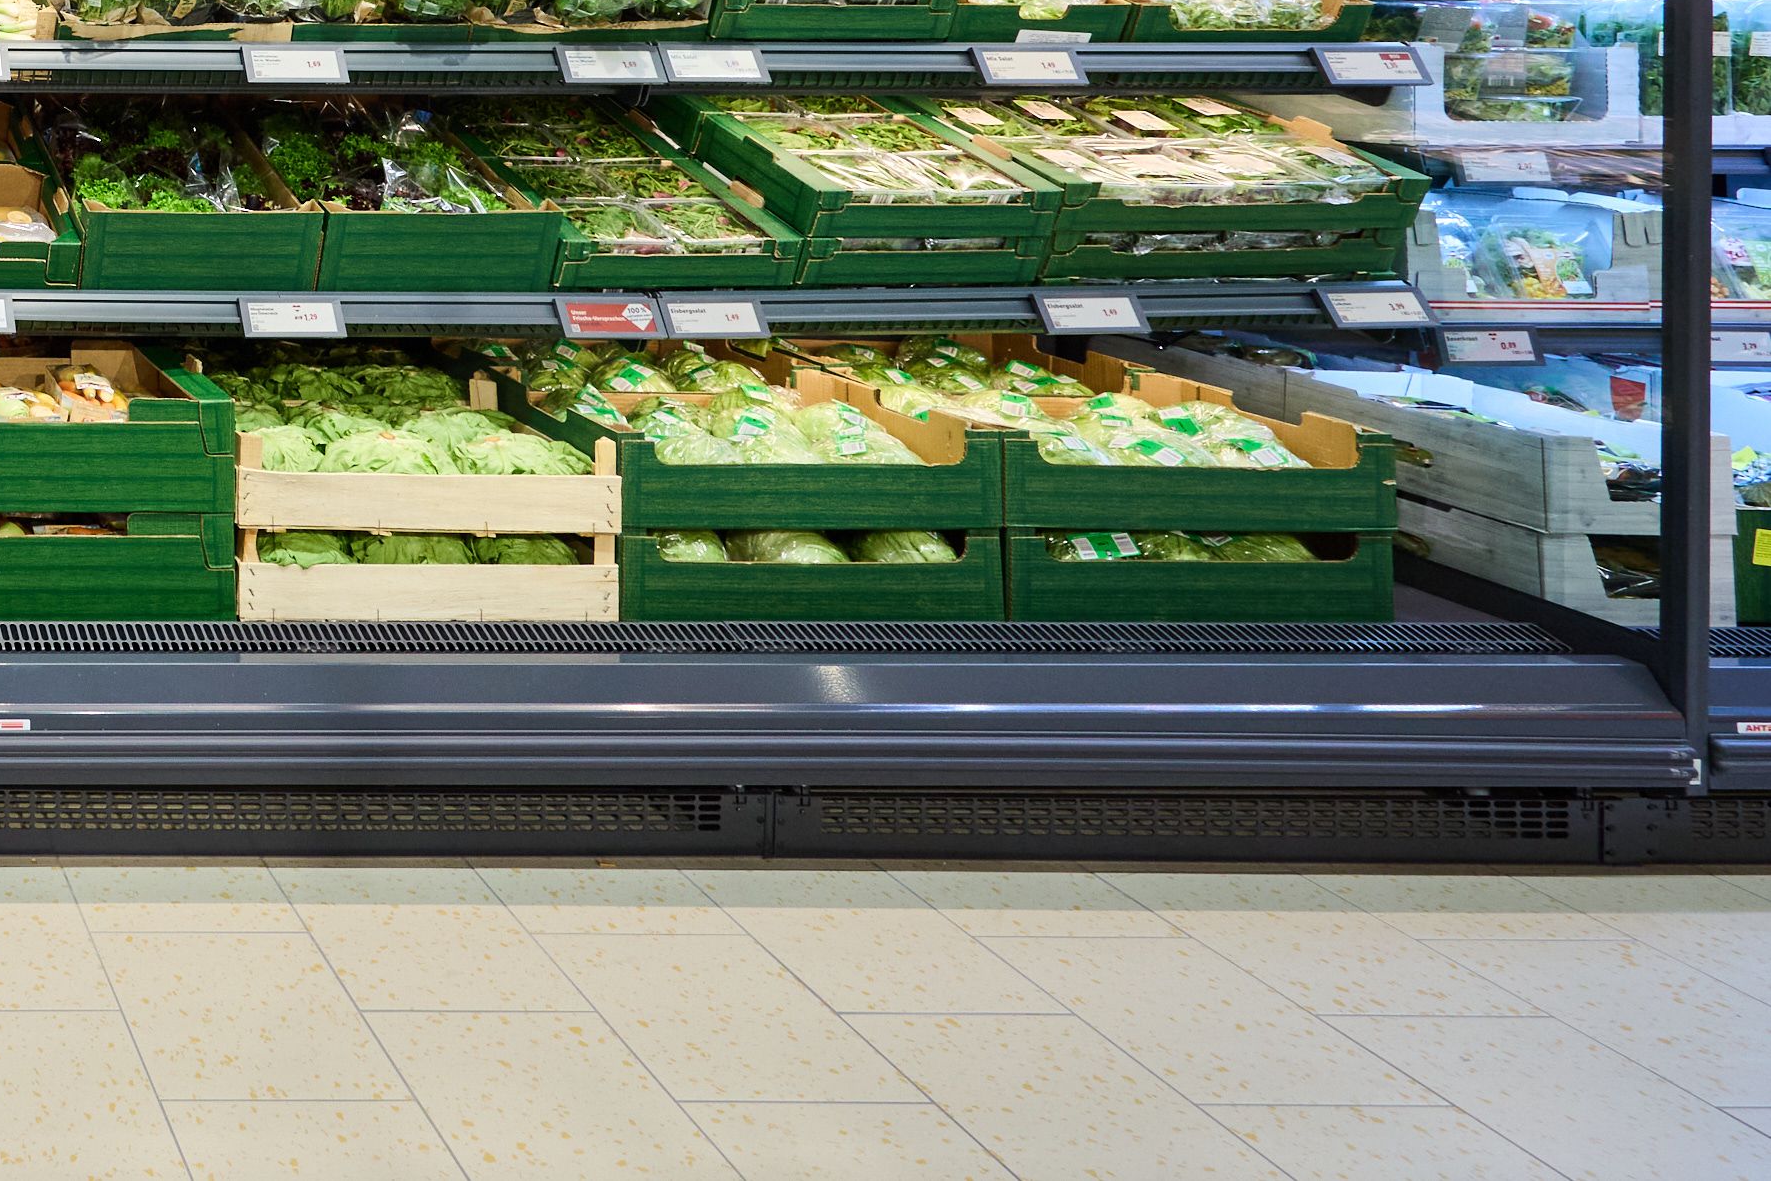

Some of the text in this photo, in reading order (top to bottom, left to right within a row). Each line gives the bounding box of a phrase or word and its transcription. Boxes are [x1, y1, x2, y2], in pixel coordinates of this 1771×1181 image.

[1103, 308, 1117, 317] 1.49
[303, 313, 317, 321] 1.29
[725, 314, 739, 322] 1.49
[1746, 724, 1769, 732] AHT
